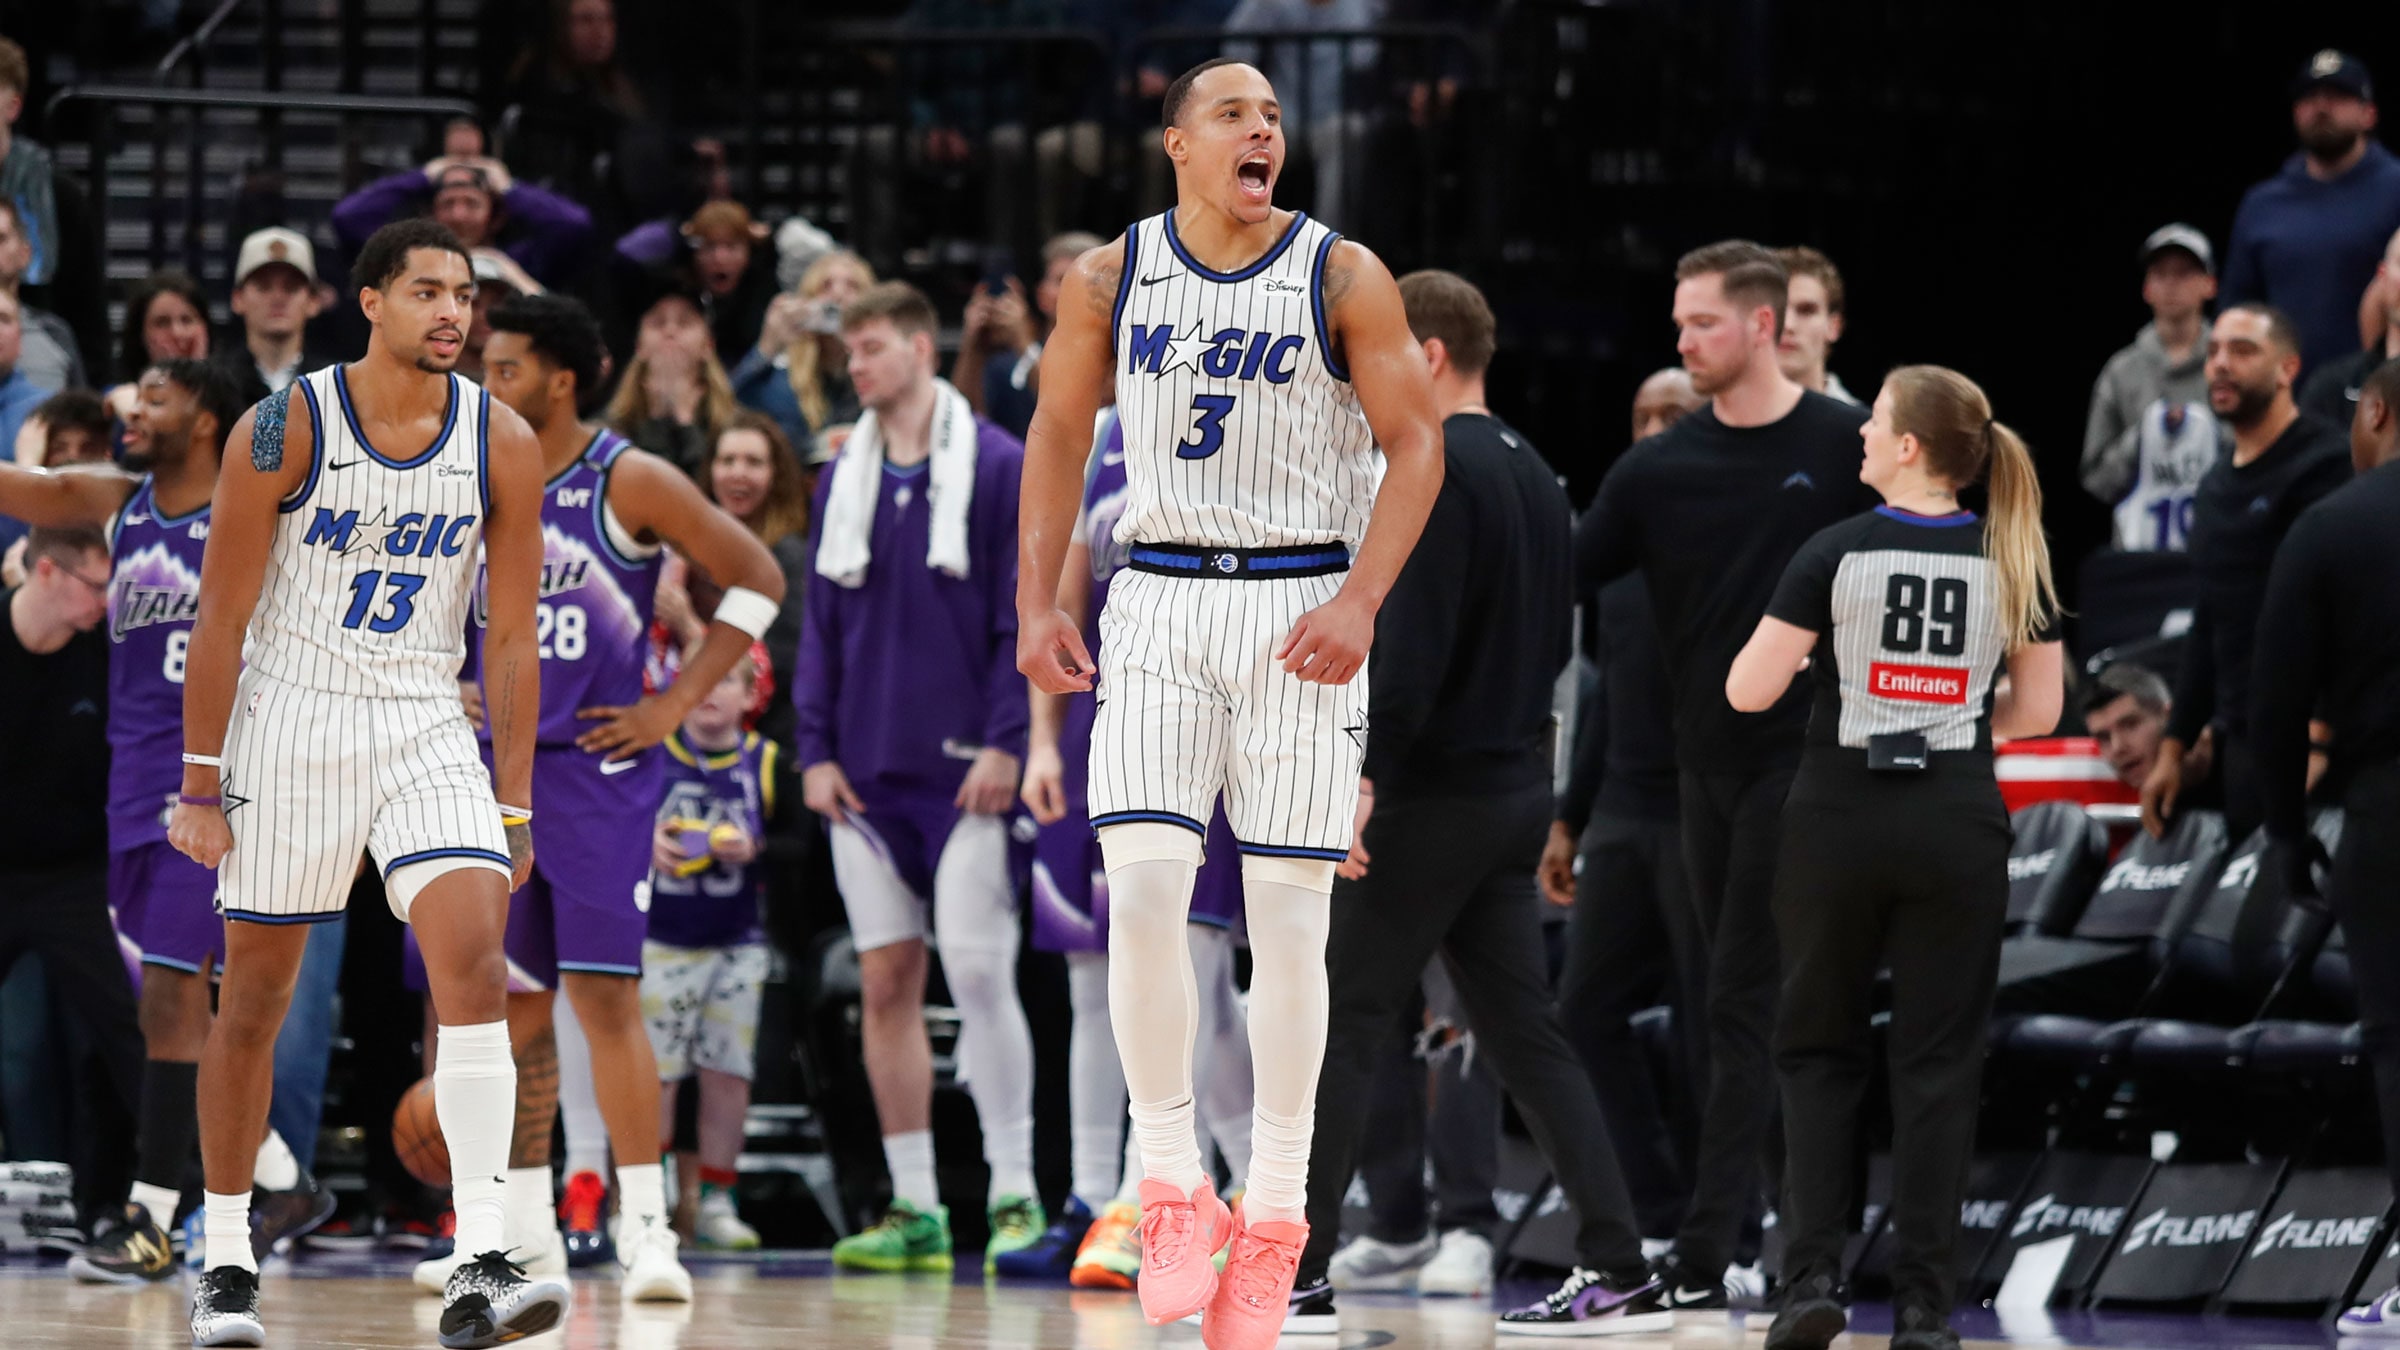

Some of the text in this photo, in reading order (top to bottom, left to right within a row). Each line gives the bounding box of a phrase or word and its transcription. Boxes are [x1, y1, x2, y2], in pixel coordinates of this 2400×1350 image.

[1176, 394, 1237, 460] 3
[341, 569, 427, 634] 13
[535, 603, 587, 661] 28
[1881, 573, 1968, 657] 89
[1877, 670, 1960, 696] Emirates
